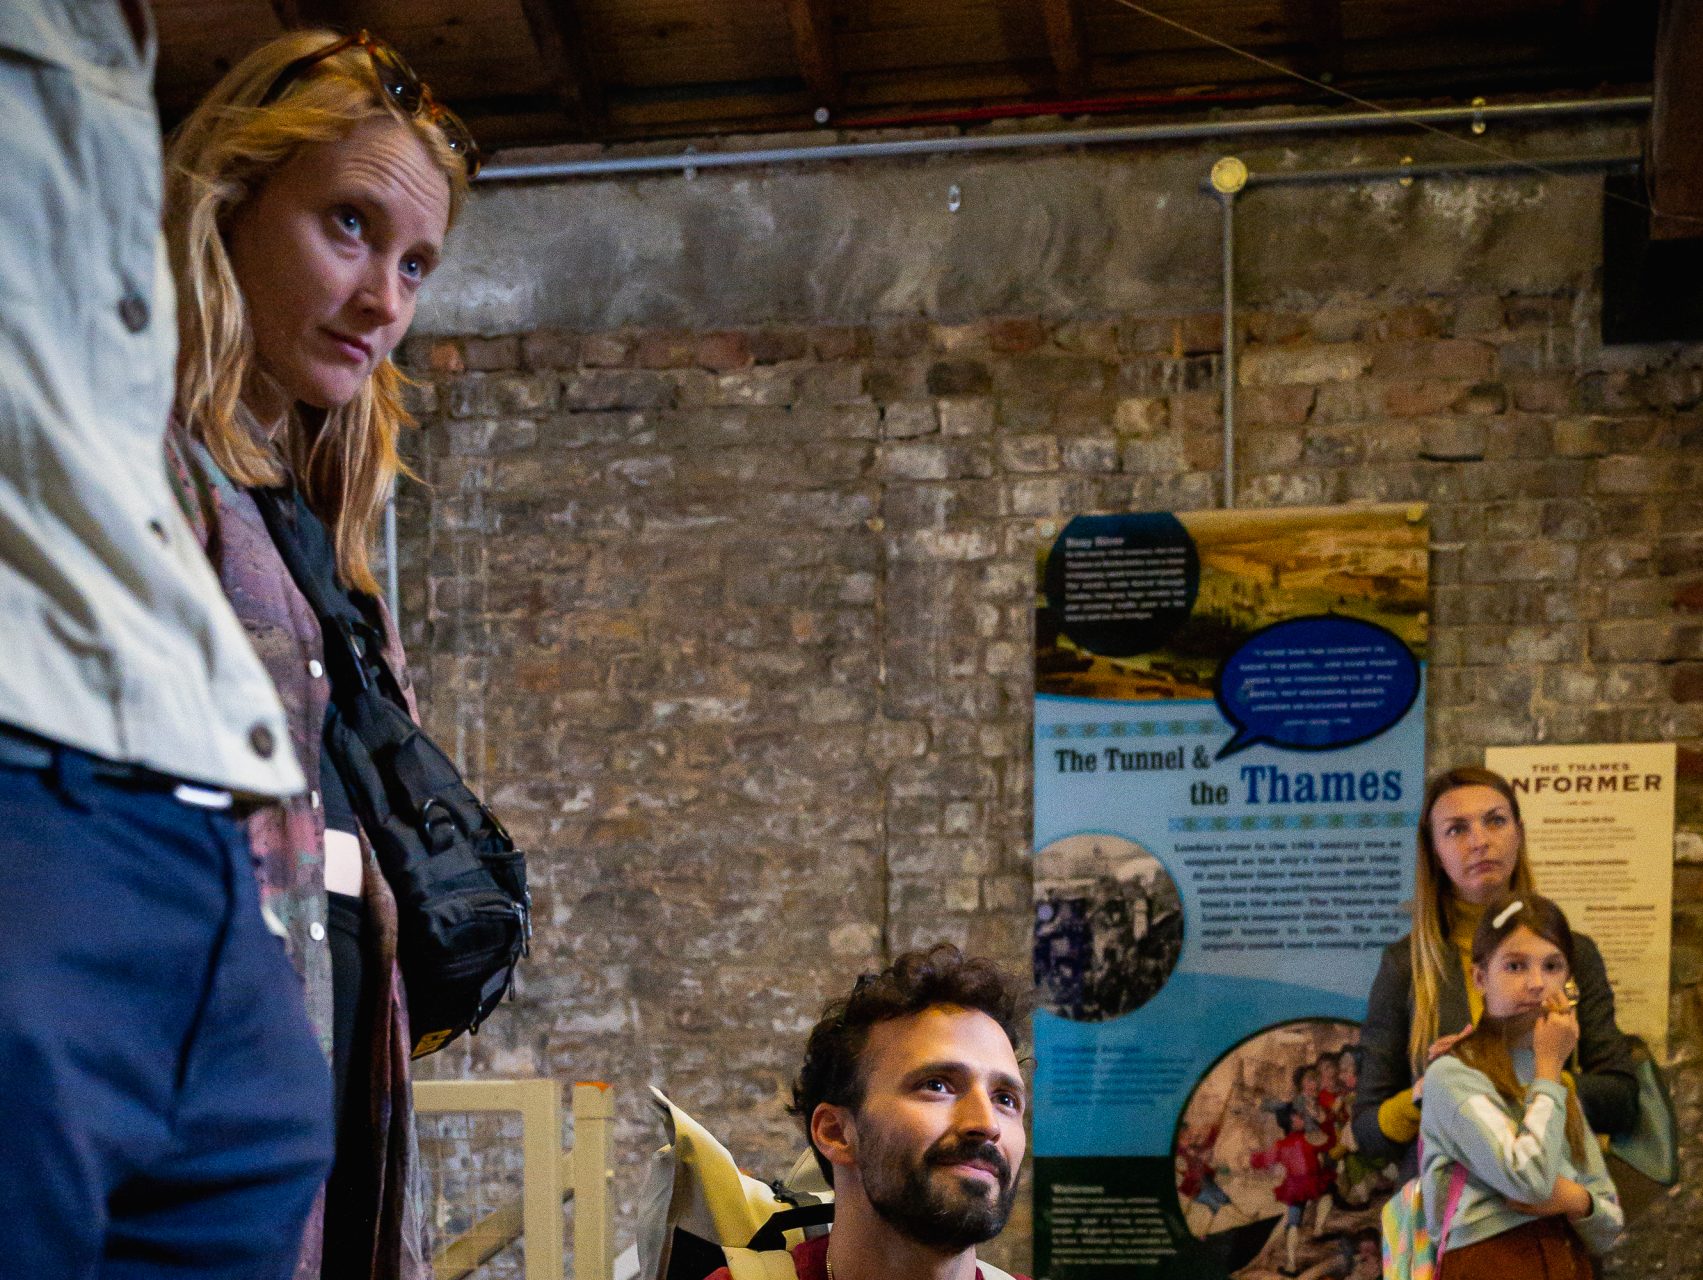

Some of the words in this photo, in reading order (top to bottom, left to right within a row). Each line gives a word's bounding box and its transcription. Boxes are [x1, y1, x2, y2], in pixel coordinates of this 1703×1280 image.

[1054, 748, 1097, 773] The
[1104, 746, 1185, 772] Tunnel
[1192, 745, 1211, 769] &
[1532, 763, 1560, 774] THE
[1568, 762, 1631, 773] THAMES
[1190, 781, 1229, 806] the
[1240, 764, 1403, 805] Thames
[1511, 774, 1662, 794] NFORMER
